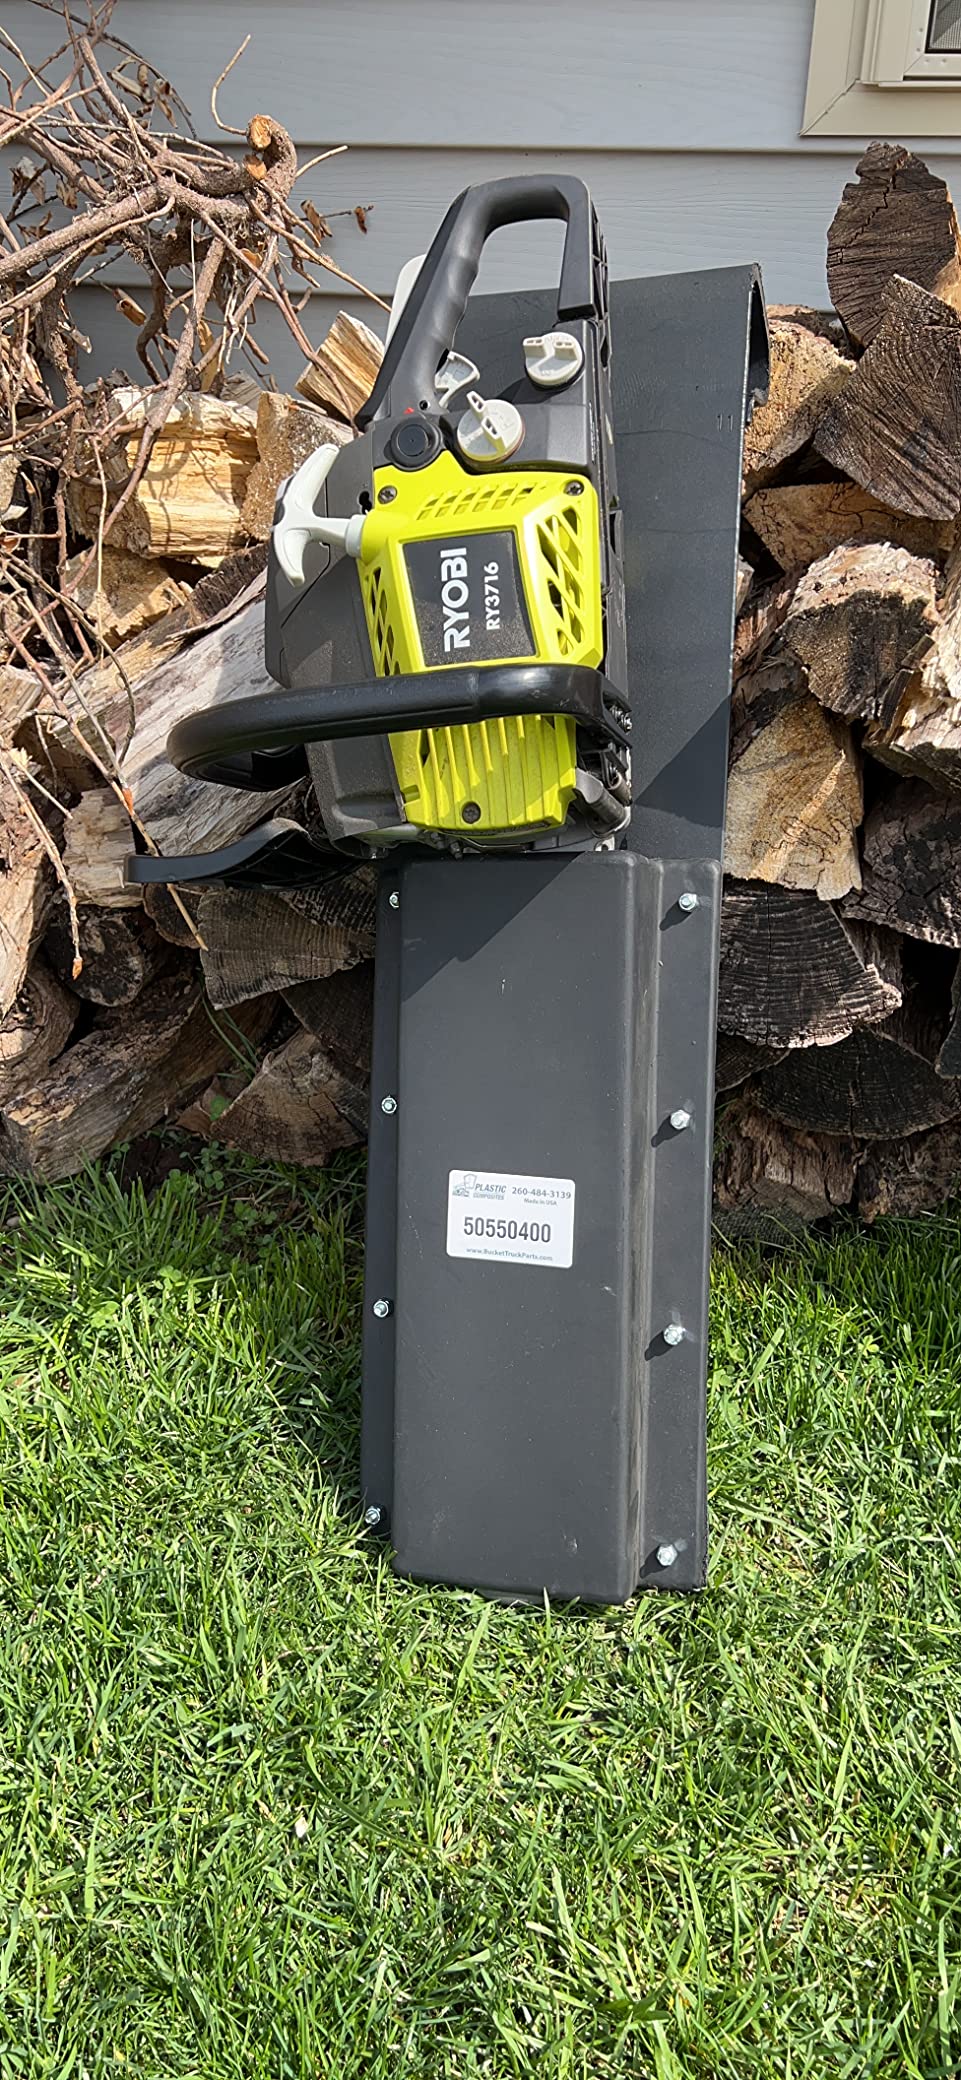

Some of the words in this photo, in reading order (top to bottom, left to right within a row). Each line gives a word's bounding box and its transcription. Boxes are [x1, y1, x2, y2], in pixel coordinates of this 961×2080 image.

[440, 547, 471, 653] RYOBI
[484, 561, 501, 631] RY3716
[474, 1183, 507, 1194] PLASTIC
[511, 1186, 572, 1200] 260-484-3139
[473, 1192, 505, 1201] COMPOSITES
[463, 1216, 552, 1243] 50550400
[466, 1247, 554, 1261] www.BucketTruckParts.com
